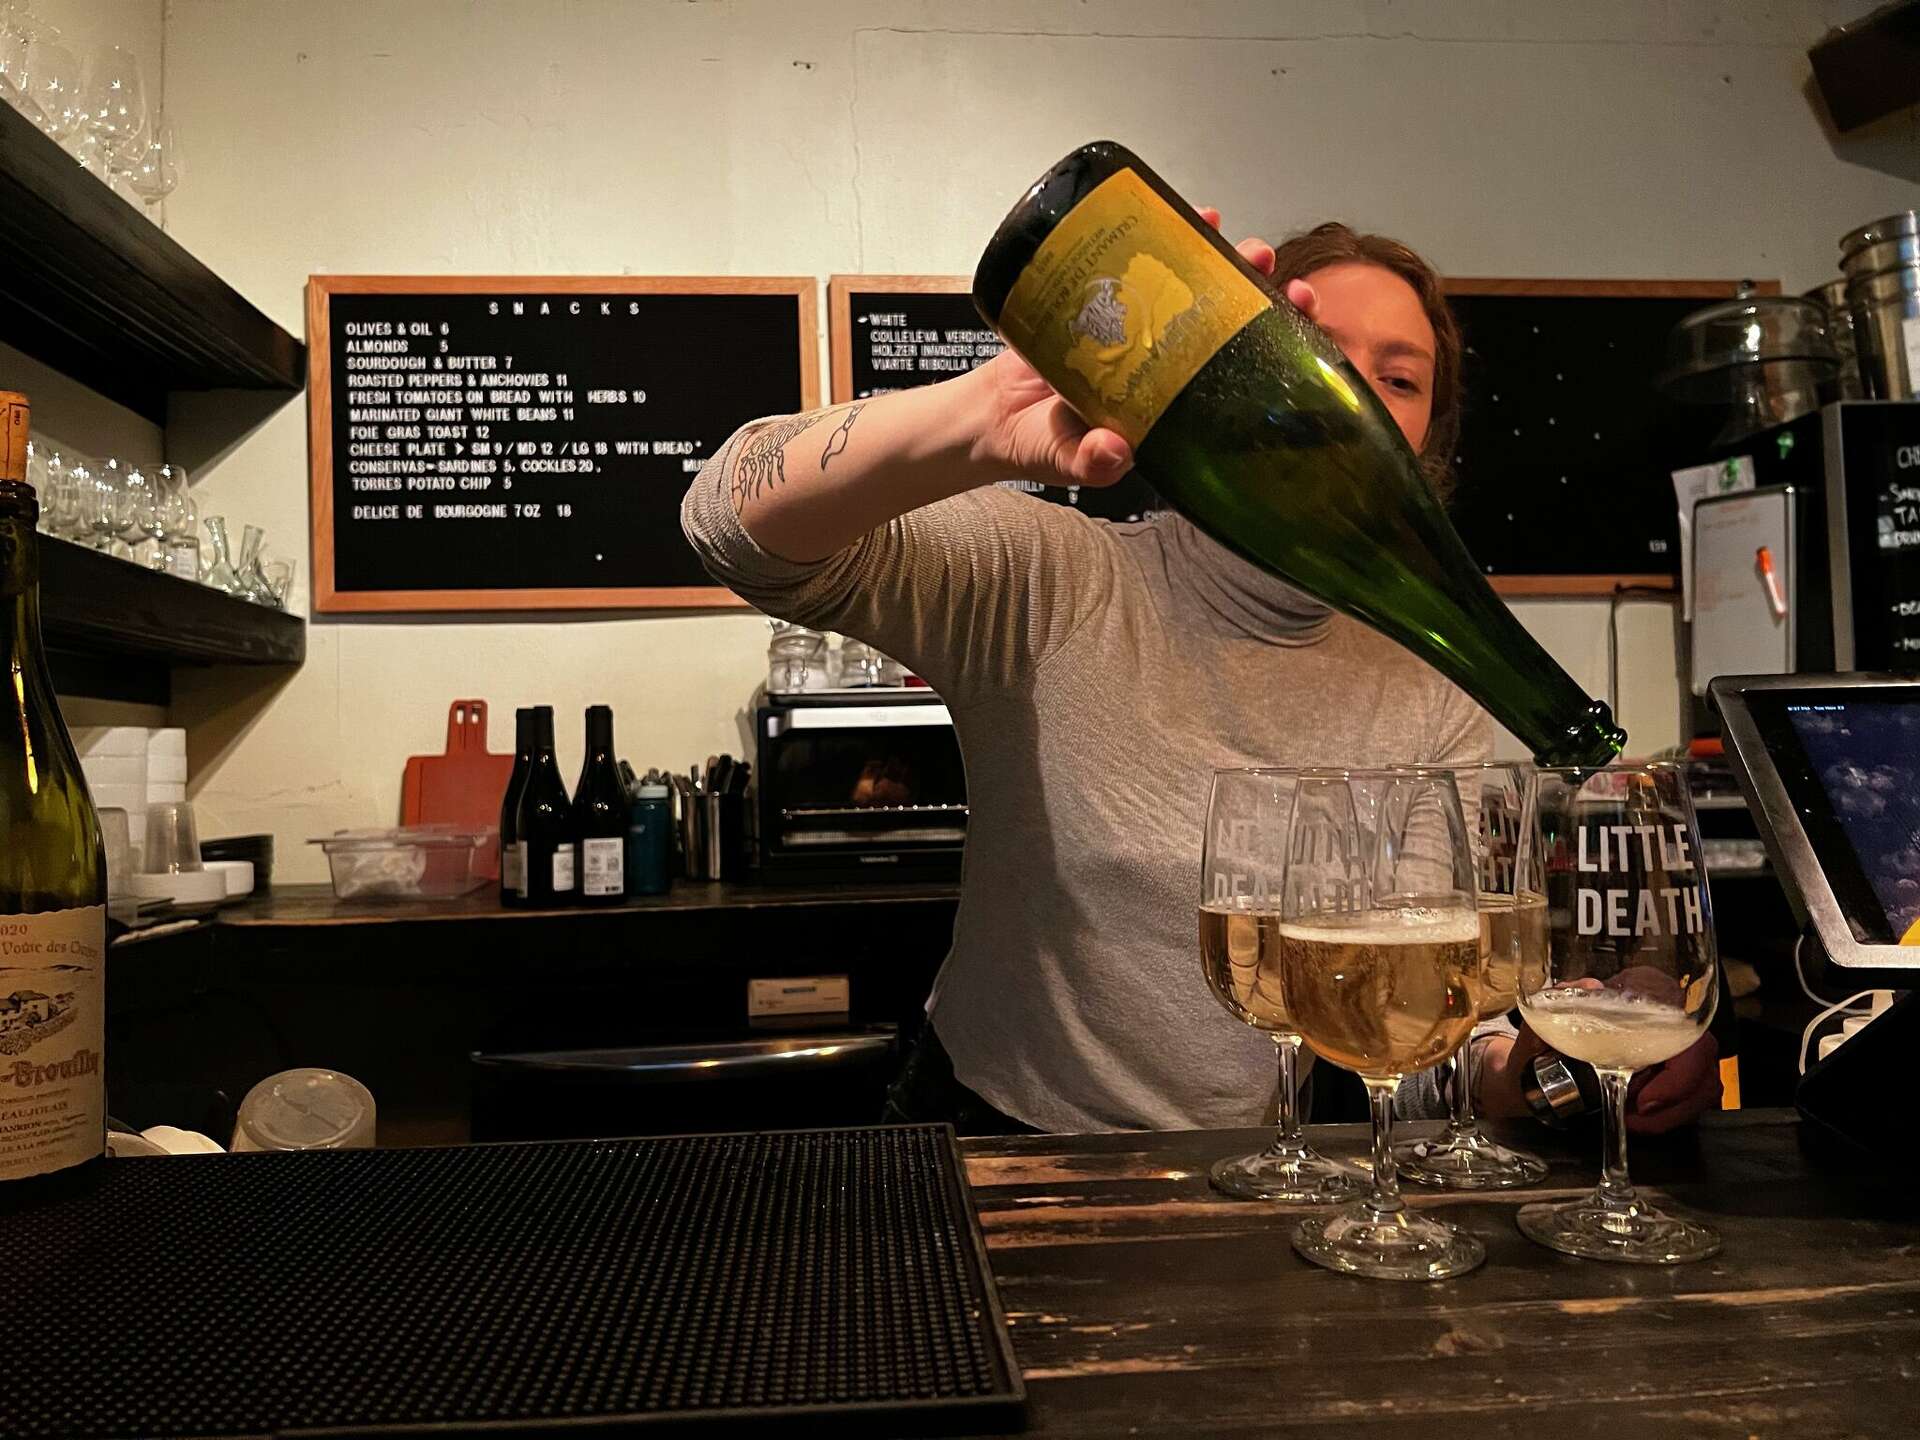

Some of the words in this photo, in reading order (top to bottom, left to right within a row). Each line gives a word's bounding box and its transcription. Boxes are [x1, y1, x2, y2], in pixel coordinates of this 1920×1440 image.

[869, 313, 907, 326] WHITE
[346, 322, 392, 336] OLIVES
[397, 322, 407, 336] &
[410, 322, 432, 336] OIL
[346, 339, 408, 353] ALMONDS
[871, 345, 917, 357] HOLZER
[347, 356, 426, 370] SOURDOUGH
[433, 357, 443, 369] &
[449, 356, 496, 369] BUTTER
[505, 356, 512, 369] 7
[348, 374, 404, 387] ROASTED
[408, 374, 462, 387] PEPPERS
[466, 374, 476, 387] &
[480, 374, 549, 387] ANCHOVIES
[556, 374, 568, 387] 11
[350, 391, 390, 404] FRESH
[395, 391, 462, 404] TOMATOES
[466, 390, 484, 404] ON
[490, 390, 531, 404] BREAD
[538, 390, 573, 403] WITH
[587, 390, 627, 403] HERBS
[633, 390, 646, 403] 10
[350, 408, 421, 422] MARINATED
[425, 408, 463, 421] GIANT
[470, 408, 510, 421] WHITE
[517, 408, 557, 421] BEANS
[563, 408, 574, 421] 11
[350, 426, 379, 439] FOIE
[386, 426, 421, 439] GRAS
[427, 426, 468, 439] TOAST
[476, 426, 490, 439] 12
[350, 443, 400, 456] CHEESE
[406, 443, 446, 456] PLATE
[471, 443, 490, 456] SM
[517, 443, 537, 455] MD
[541, 443, 553, 455] 12
[572, 442, 589, 455] LG
[595, 442, 608, 455] 18
[615, 442, 649, 455] WITH
[353, 477, 401, 490] TORRES
[407, 477, 455, 490] POTATO
[460, 477, 491, 490] CHIP
[503, 477, 512, 490] 5
[354, 505, 399, 519] DELICE
[406, 505, 423, 519] DE
[435, 504, 508, 518] BOURGOGNE
[556, 504, 572, 517] 18
[1578, 824, 1694, 872] LITTLE
[1578, 887, 1703, 936] DEATH
